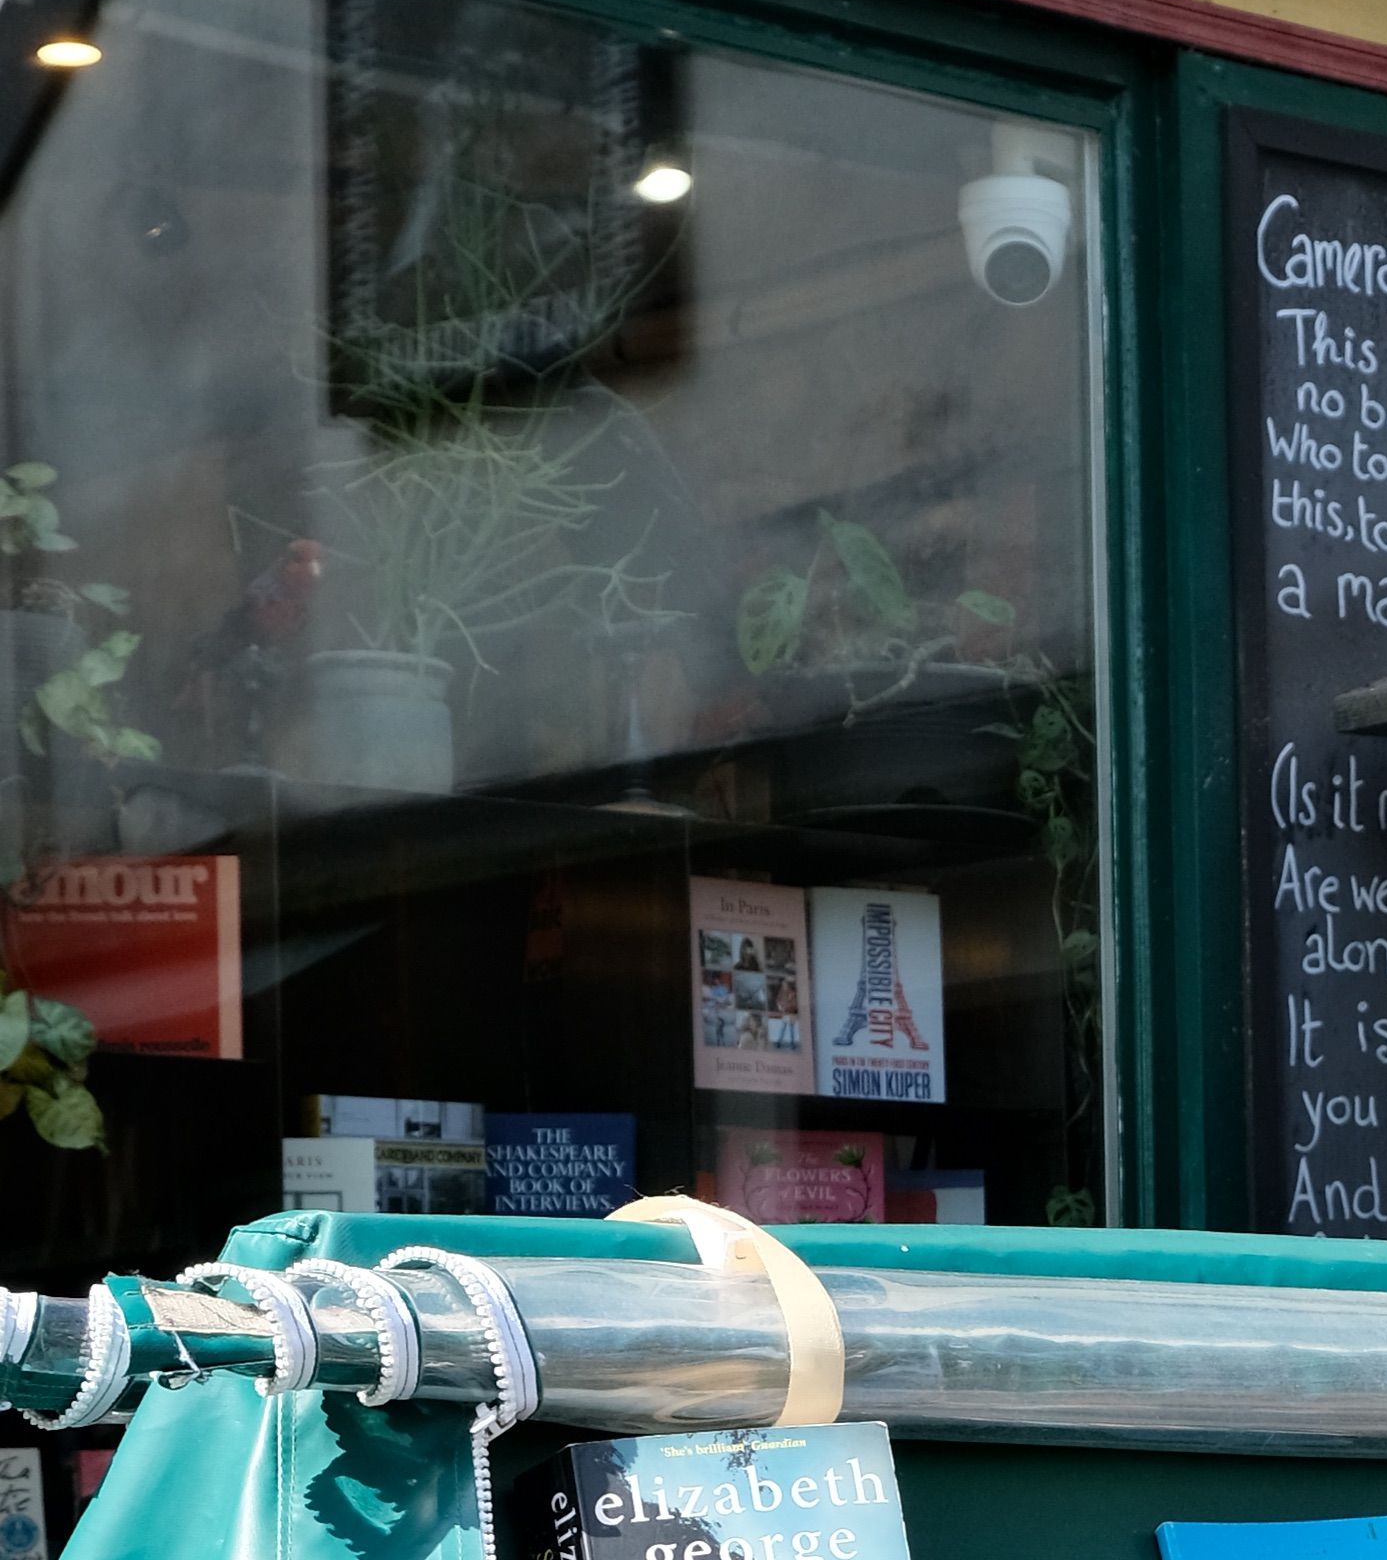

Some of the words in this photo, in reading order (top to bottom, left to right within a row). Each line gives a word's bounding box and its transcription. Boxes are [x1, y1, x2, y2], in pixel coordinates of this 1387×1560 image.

[1276, 308, 1378, 375] This
[1297, 381, 1345, 418] no
[1272, 478, 1354, 542] this,
[1277, 563, 1312, 619] a
[1271, 742, 1317, 829] (Is
[1332, 754, 1364, 832] it
[1275, 843, 1340, 913] Are
[866, 903, 893, 1006] IMPOSSIBLE
[868, 1008, 894, 1049] CITY
[1287, 994, 1323, 1068] It
[832, 1068, 880, 1098] SIMON
[886, 1071, 931, 1100] KUPER
[532, 1127, 572, 1144] THE
[1295, 1089, 1379, 1152] you
[487, 1144, 617, 1161] SHAKESPEARE
[528, 1161, 625, 1177] COMPANY
[509, 1178, 564, 1194] BOOK
[570, 1178, 595, 1194] OF
[1288, 1156, 1387, 1224] And
[594, 1457, 889, 1526] elizabeth
